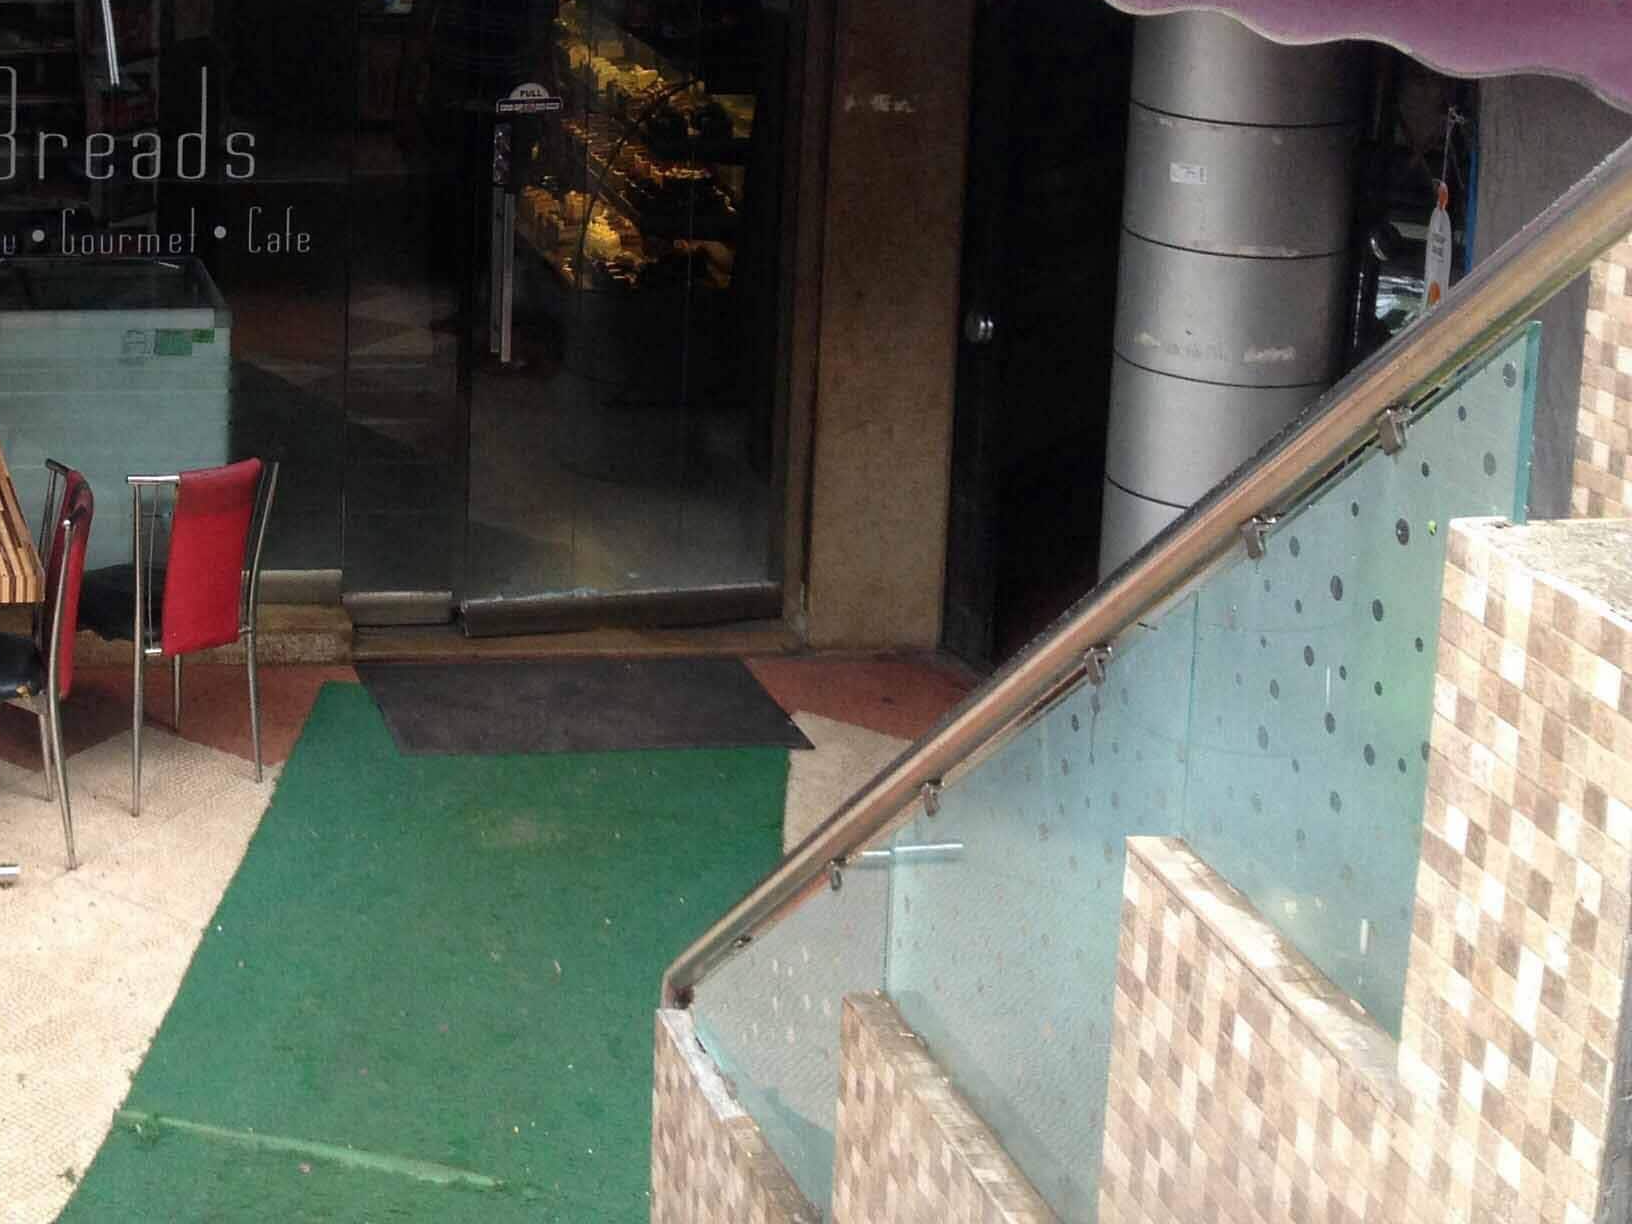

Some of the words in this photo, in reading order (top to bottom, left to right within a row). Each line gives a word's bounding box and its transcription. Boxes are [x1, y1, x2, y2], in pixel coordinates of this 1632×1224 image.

[519, 88, 544, 97] PULL
[61, 207, 196, 256] Gourmet
[248, 206, 311, 254] Cafe
